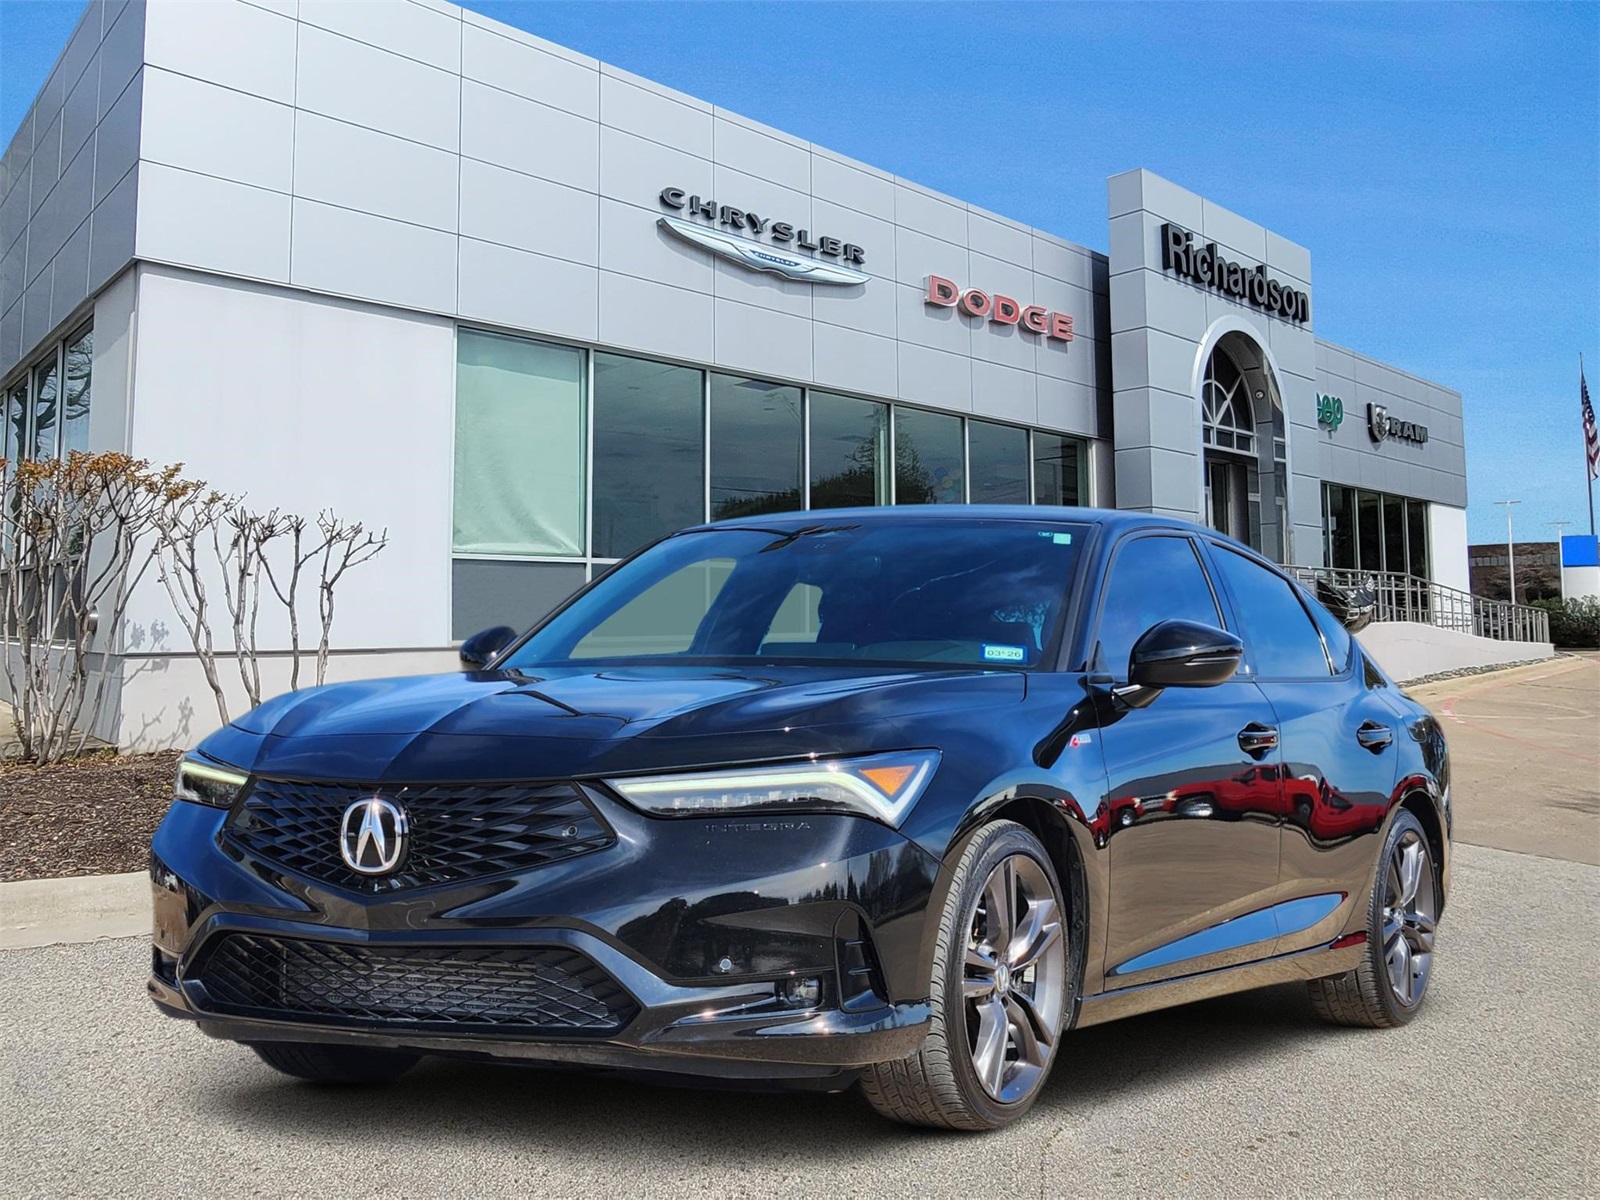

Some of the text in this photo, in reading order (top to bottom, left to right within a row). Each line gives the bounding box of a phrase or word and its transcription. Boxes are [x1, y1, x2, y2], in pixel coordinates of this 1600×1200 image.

[659, 187, 866, 264] CHRYSLER
[1161, 223, 1310, 323] Richardson
[924, 274, 1074, 342] DODGE
[1387, 417, 1429, 443] RAM
[704, 821, 812, 833] INTEGRA
